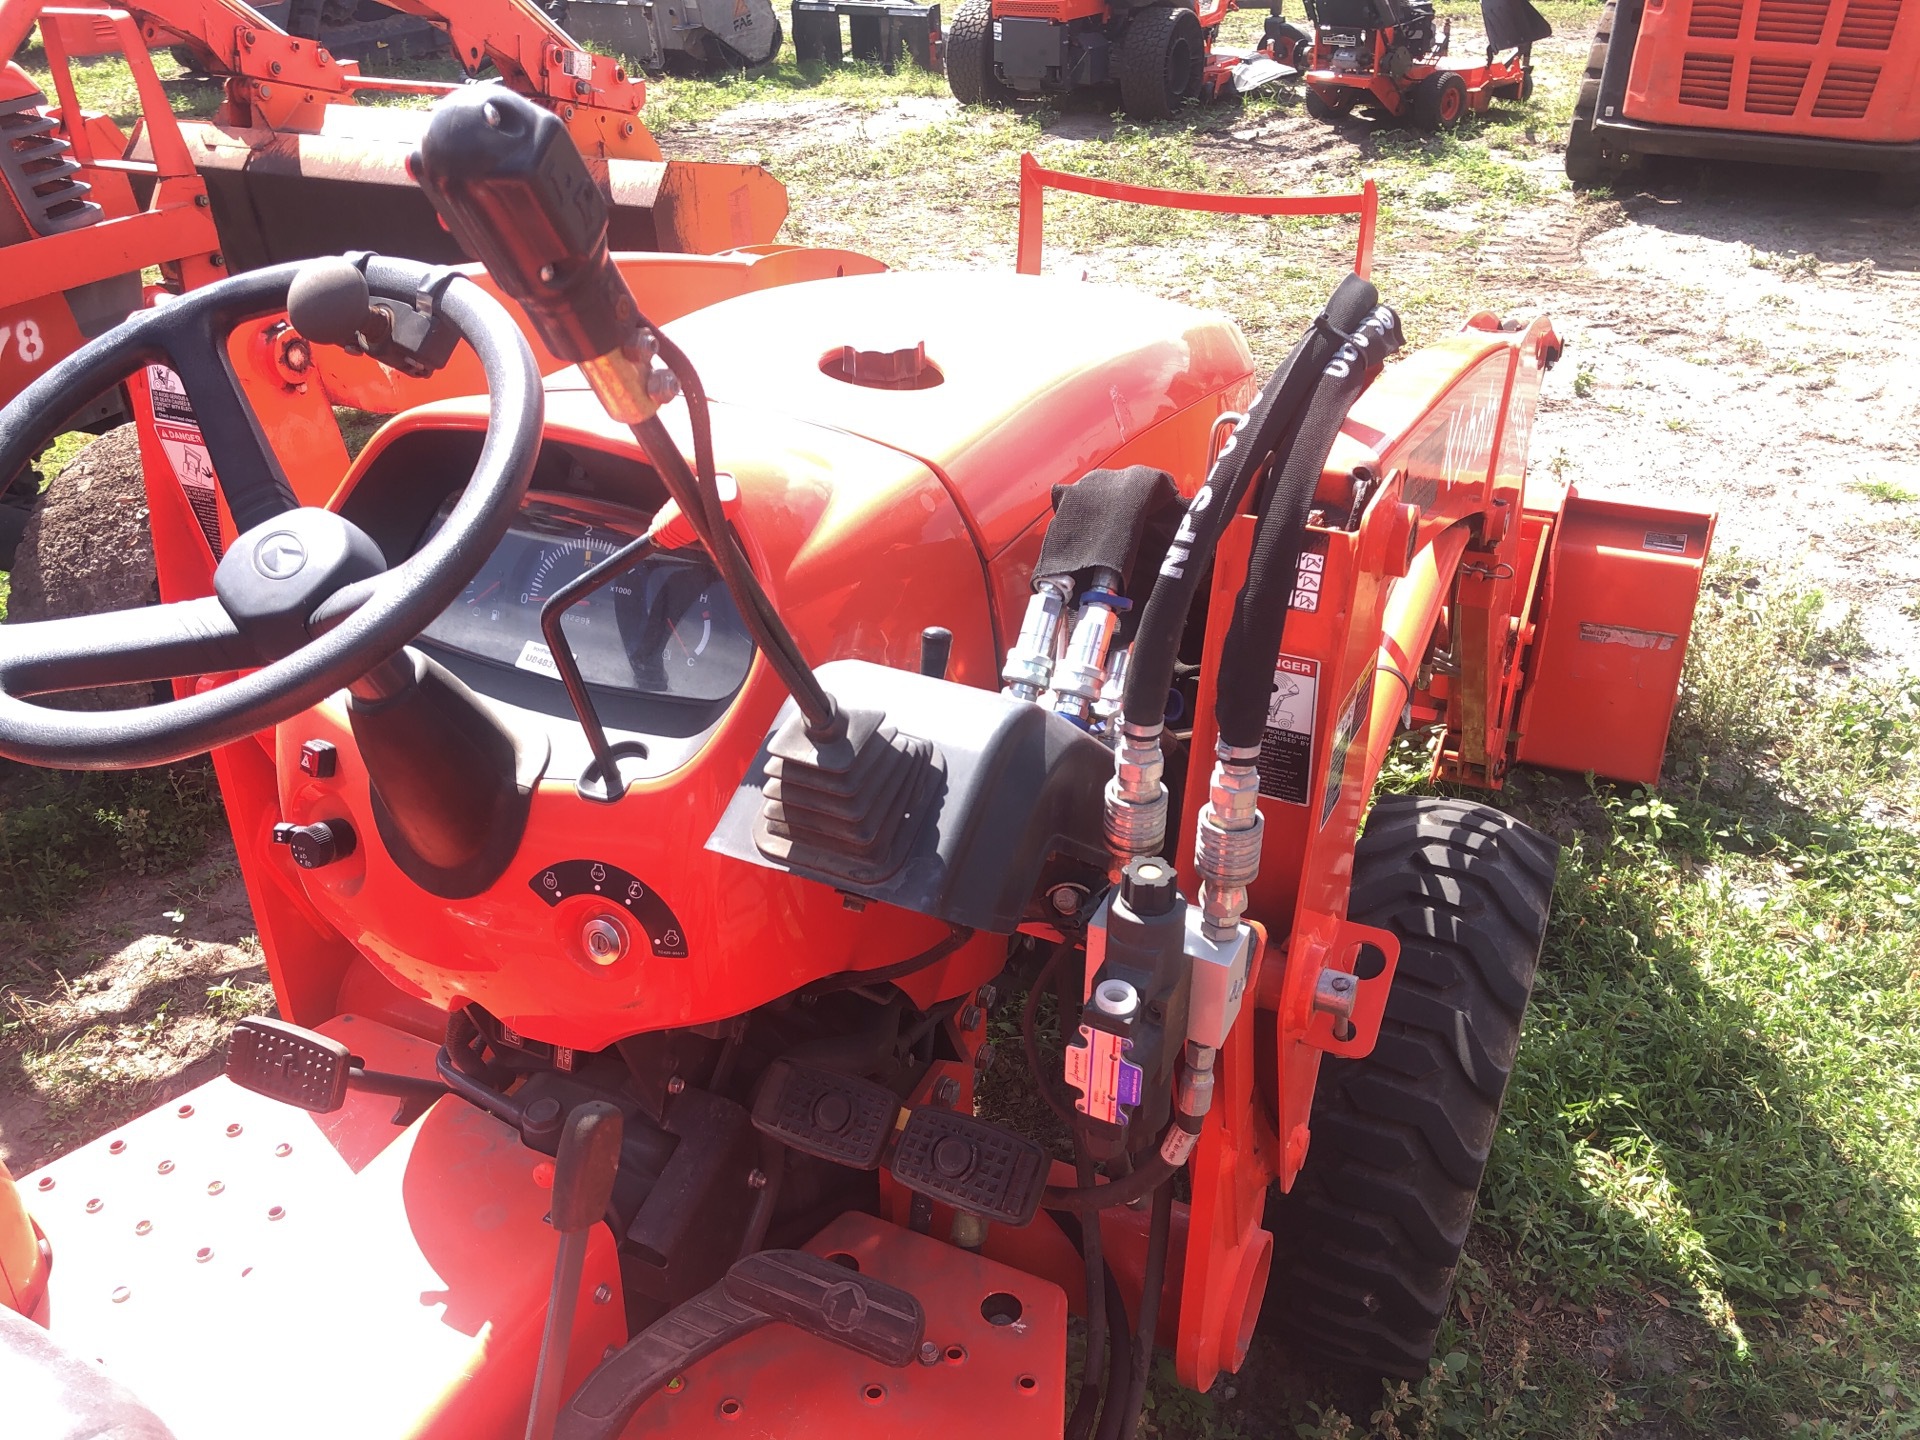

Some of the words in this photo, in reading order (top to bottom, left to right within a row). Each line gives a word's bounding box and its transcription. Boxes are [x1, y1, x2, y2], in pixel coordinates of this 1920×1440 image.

[732, 14, 753, 32] FAE
[168, 430, 203, 443] DANGER
[584, 525, 593, 536] 2
[539, 550, 546, 561] 1
[610, 585, 632, 596] x1000
[520, 593, 529, 604] 0
[699, 594, 708, 603] H
[686, 657, 695, 667] C
[1268, 734, 1297, 744] CAUSED
